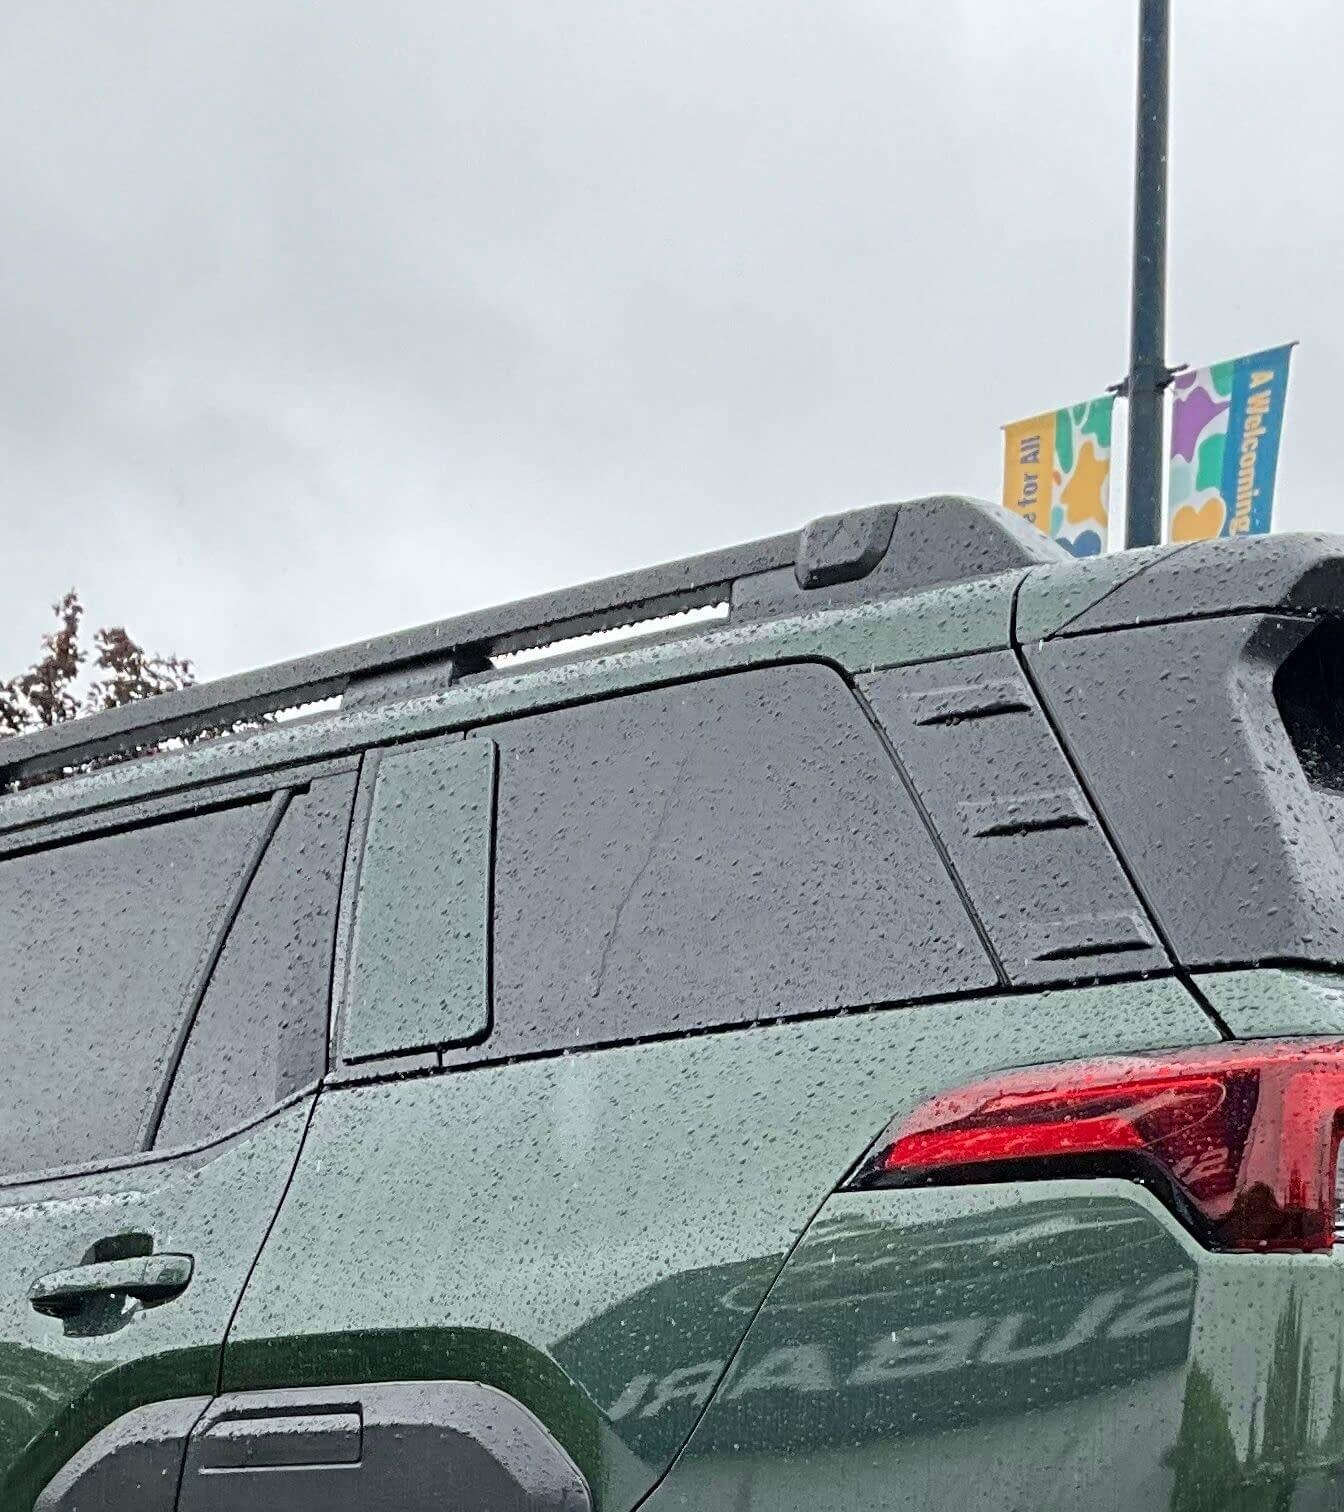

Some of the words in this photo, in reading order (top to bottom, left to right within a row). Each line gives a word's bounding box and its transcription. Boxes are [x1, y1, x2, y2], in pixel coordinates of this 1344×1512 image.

[1250, 370, 1274, 388] A
[1020, 435, 1040, 464] All
[1230, 390, 1271, 536] Welcoming
[1018, 472, 1038, 506] for
